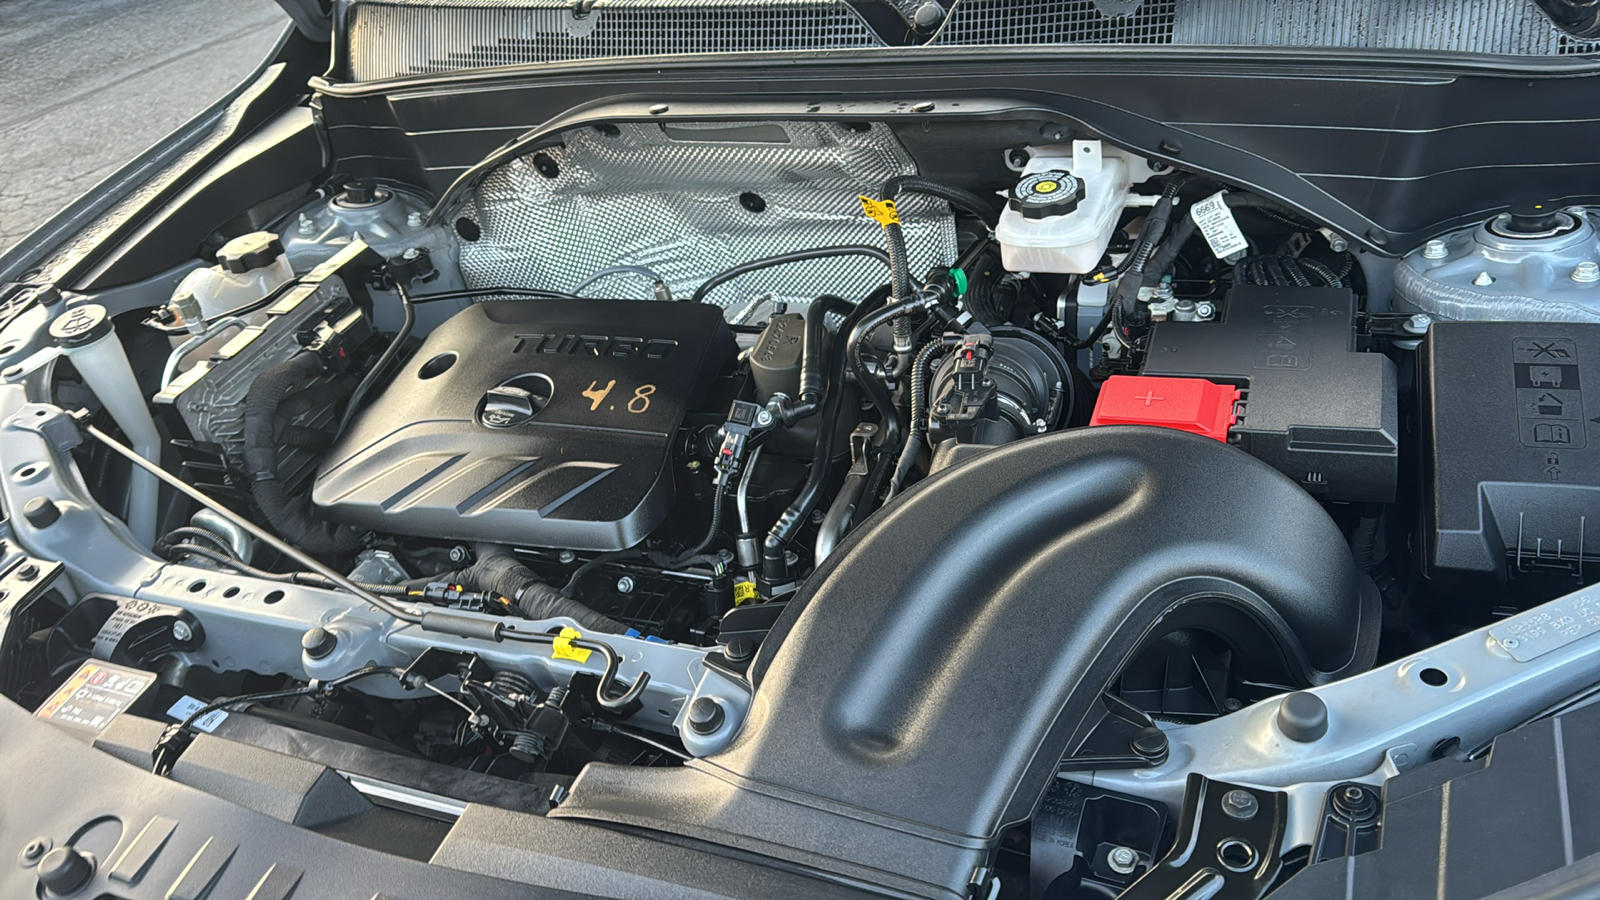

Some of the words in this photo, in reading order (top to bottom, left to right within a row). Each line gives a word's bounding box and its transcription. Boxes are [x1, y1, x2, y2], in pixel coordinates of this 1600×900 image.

[1195, 201, 1216, 217] 6669
[512, 333, 679, 359] TURBO
[581, 378, 657, 414] 4.8
